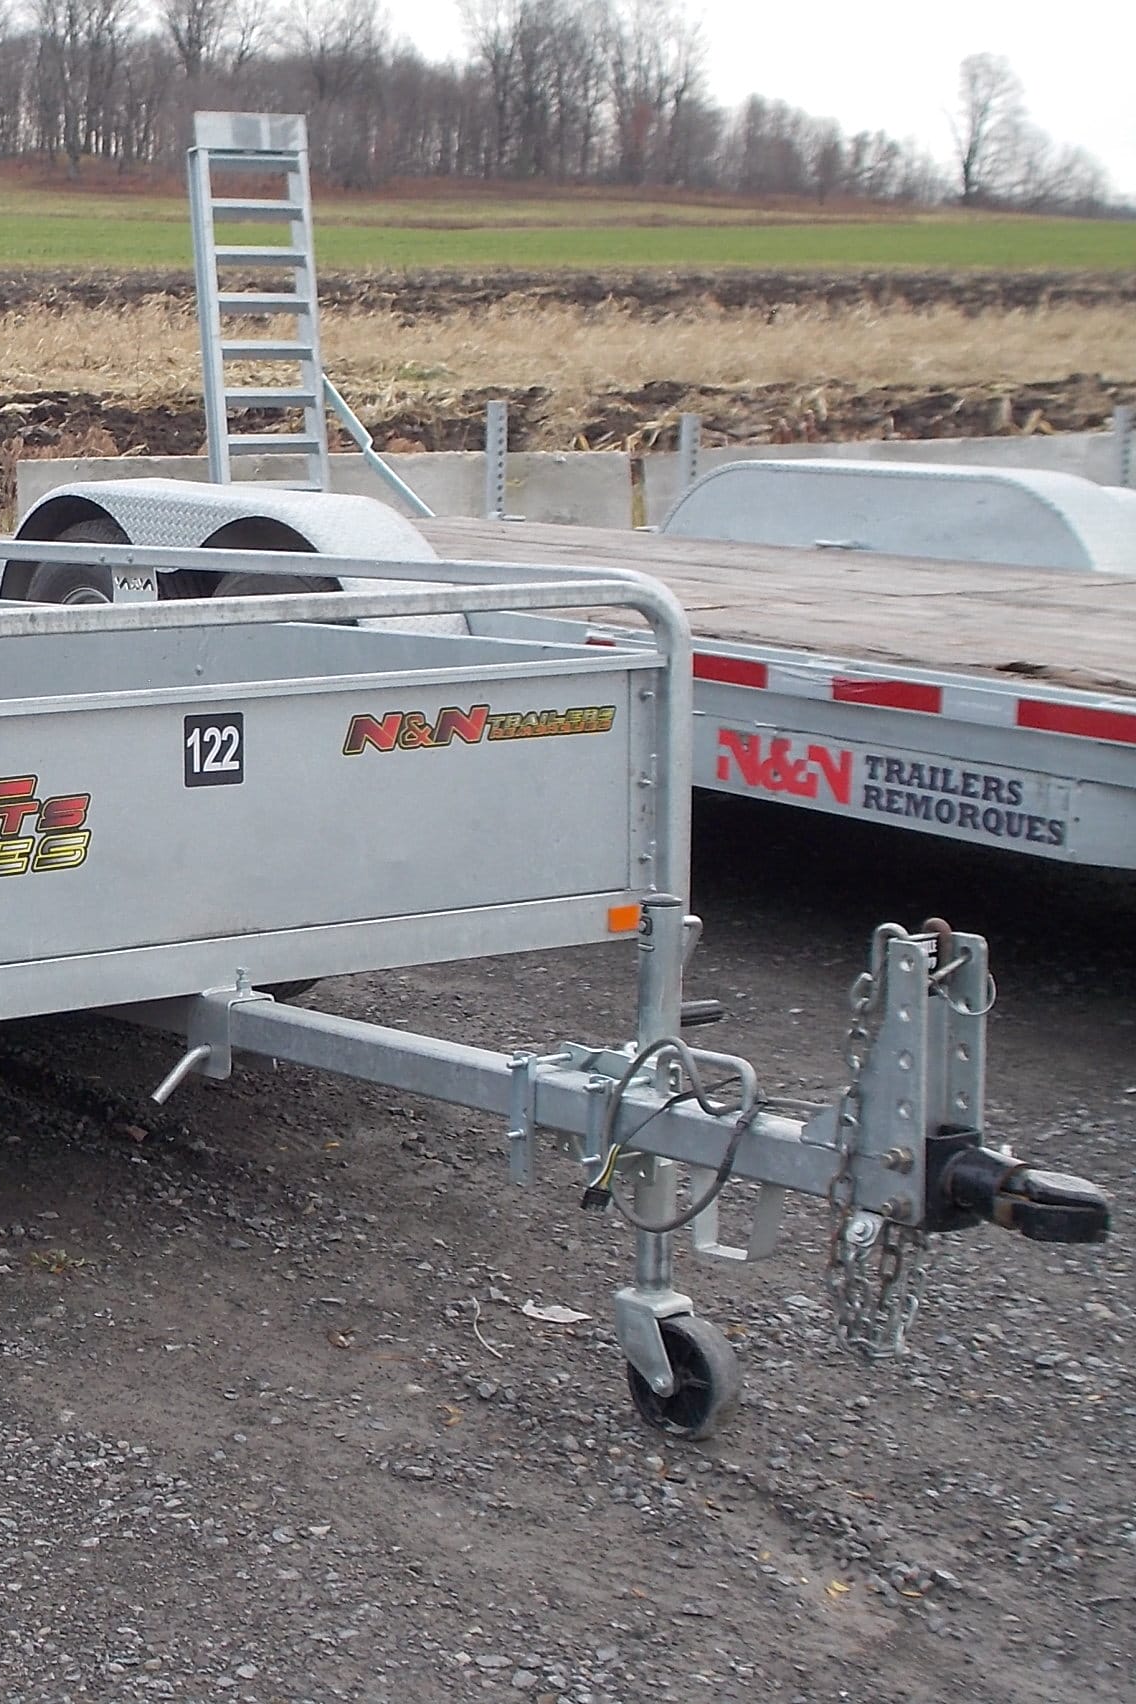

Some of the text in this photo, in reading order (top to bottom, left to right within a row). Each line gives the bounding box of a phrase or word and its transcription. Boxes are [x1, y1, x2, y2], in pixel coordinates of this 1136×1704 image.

[186, 725, 240, 773] 122
[344, 704, 615, 755] N&N TRAILERS
[717, 729, 1024, 806] N&N TRAILERS
[863, 785, 1064, 846] REMORQUES
